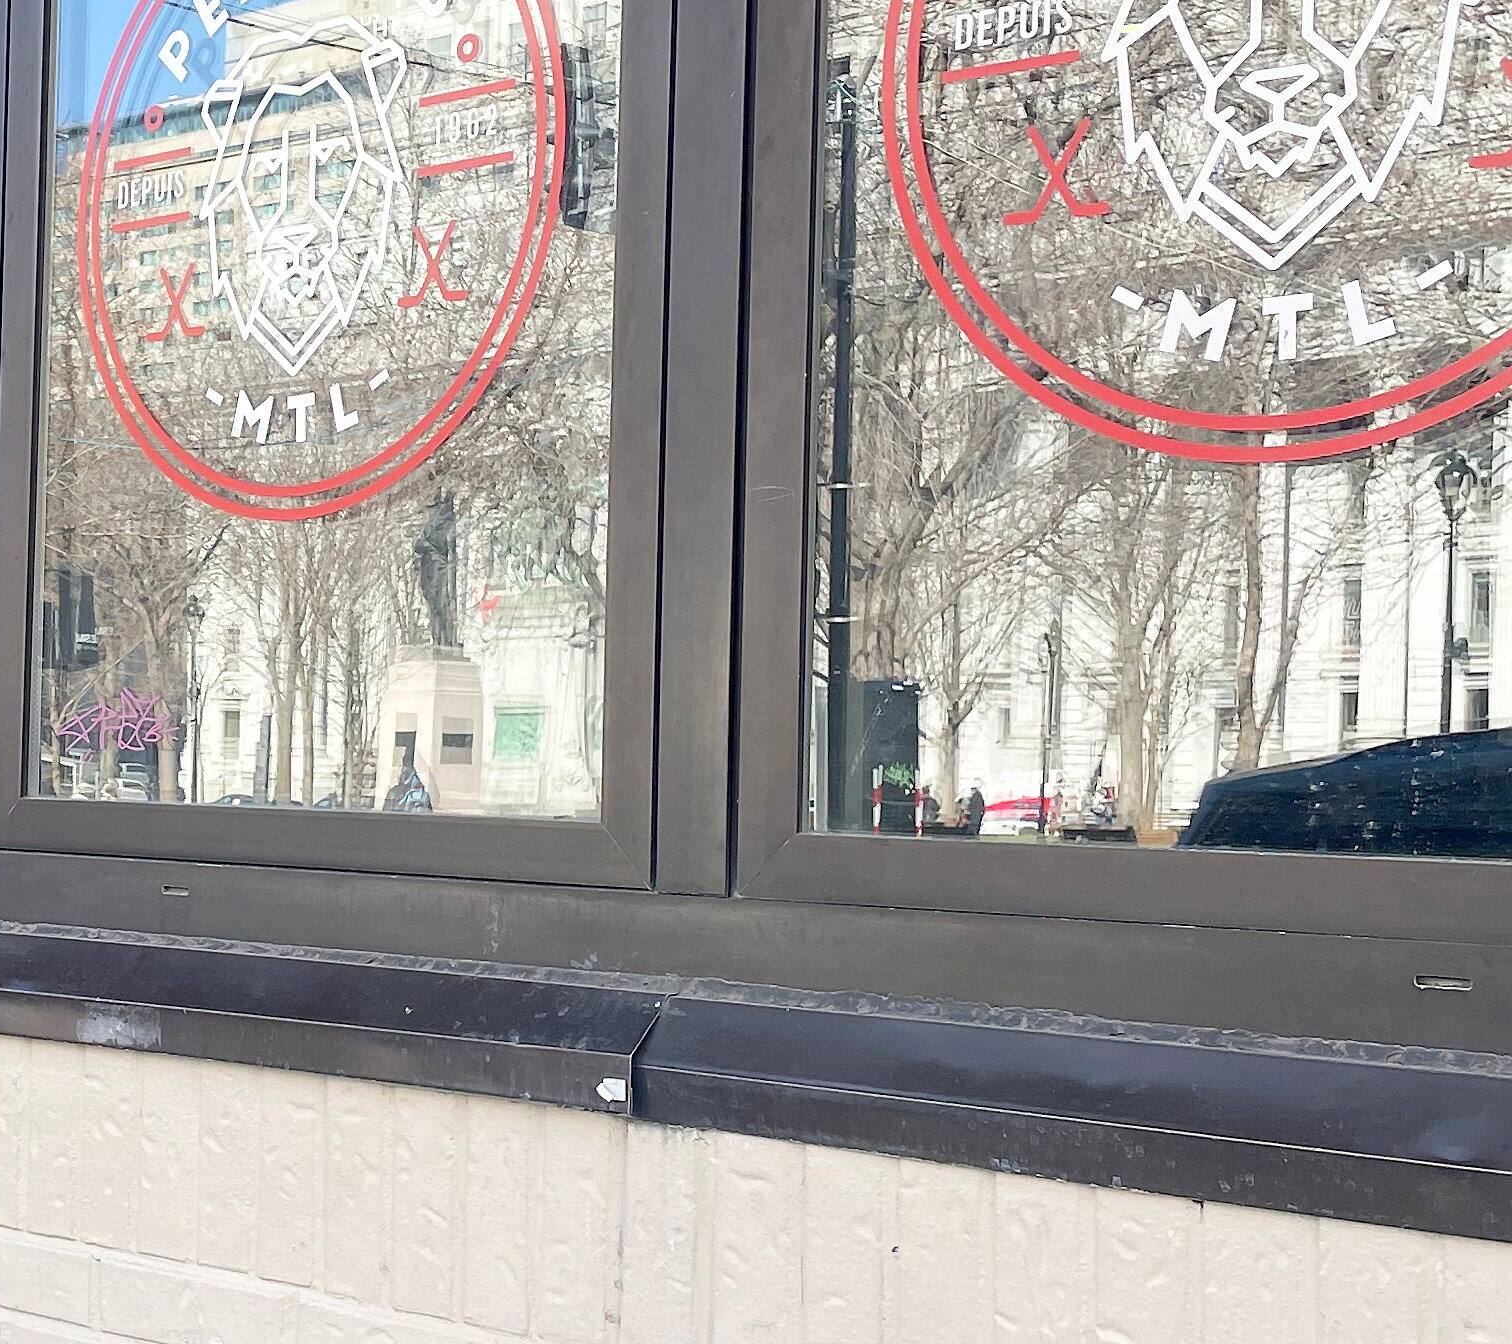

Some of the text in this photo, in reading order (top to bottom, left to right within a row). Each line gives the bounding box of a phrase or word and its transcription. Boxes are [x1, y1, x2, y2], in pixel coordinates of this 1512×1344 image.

[434, 103, 498, 145] 1962
[116, 173, 185, 211] DEPUIS
[1156, 280, 1397, 362] MTL
[230, 383, 358, 444] MTL
